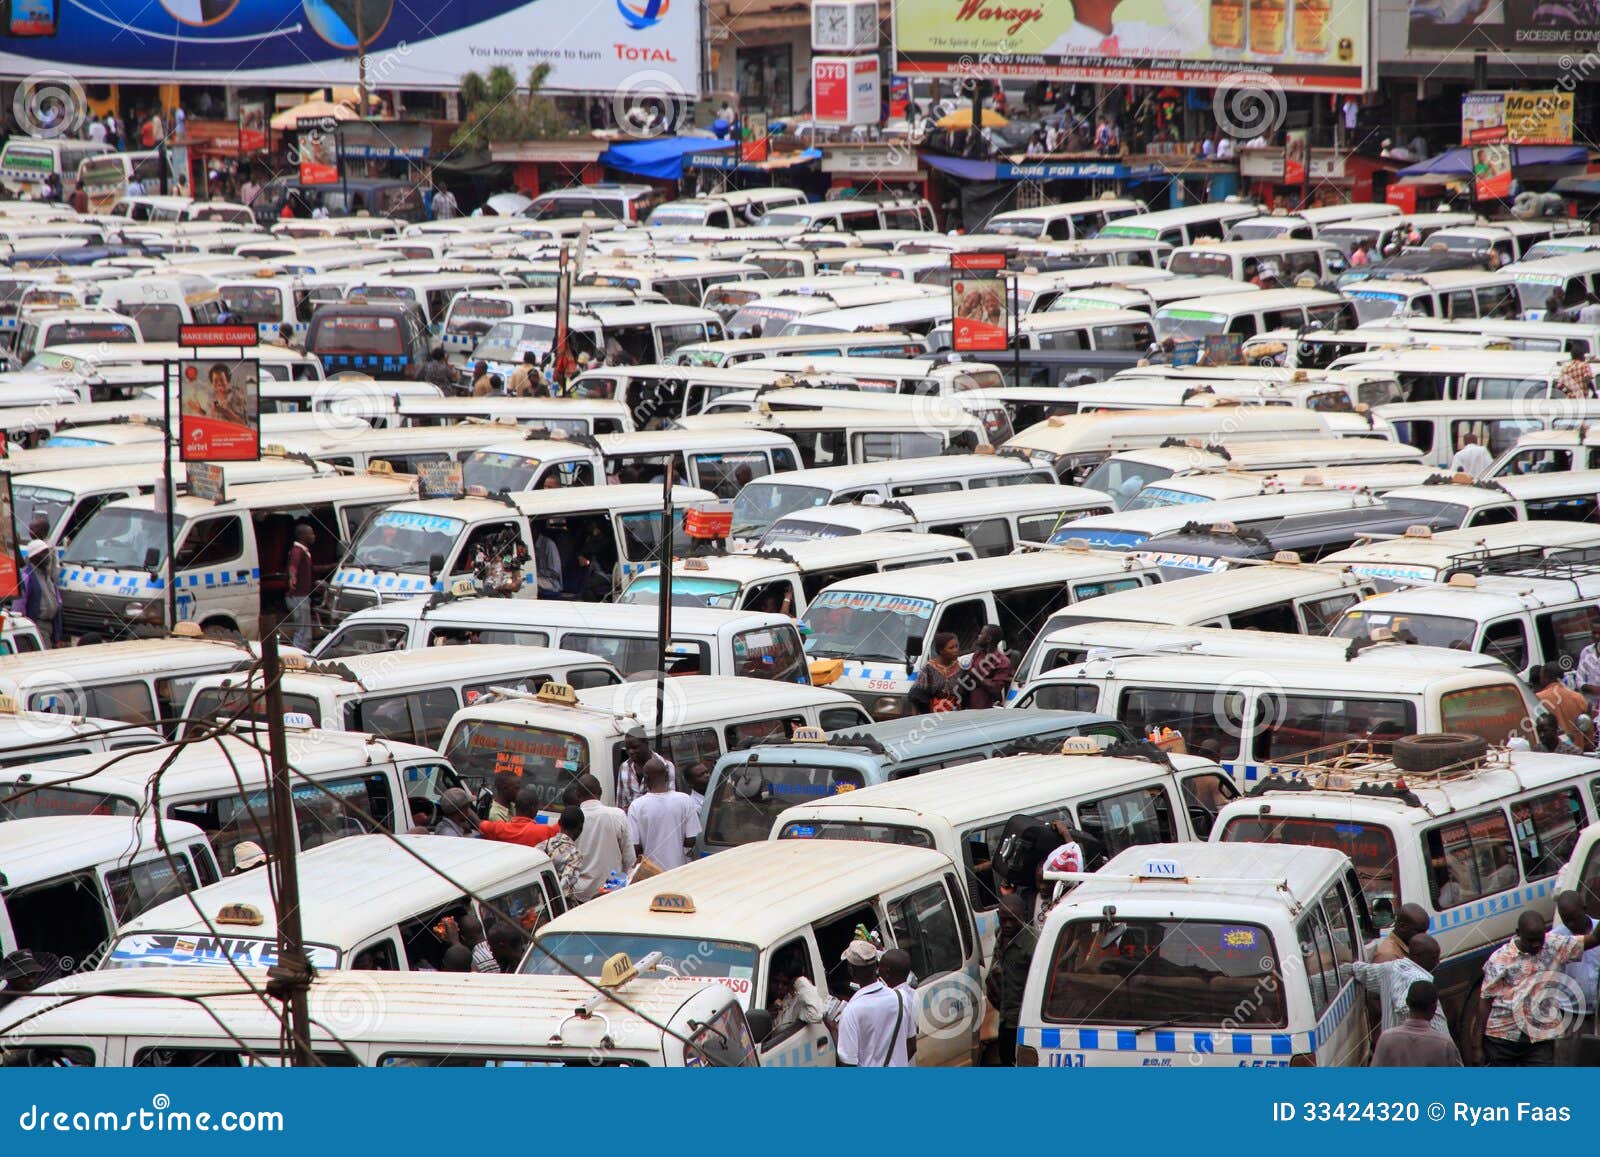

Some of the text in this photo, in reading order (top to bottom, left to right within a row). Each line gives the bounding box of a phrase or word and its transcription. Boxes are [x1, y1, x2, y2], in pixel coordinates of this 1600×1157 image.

[956, 0, 1044, 35] Waragi
[1516, 30, 1571, 40] EXCESSIVE
[468, 46, 601, 60] You know where to turn
[614, 44, 678, 62] TOTAL
[816, 65, 845, 79] DTB
[1507, 96, 1570, 110] Mobile
[1011, 166, 1045, 176] DARE
[1049, 166, 1074, 176] FOR
[187, 442, 208, 452] airtel
[389, 512, 452, 530] TOYOTA
[544, 684, 566, 696] TAXI
[868, 680, 896, 690] 598C
[796, 731, 818, 739] TAXI
[1146, 864, 1176, 874] TAXI
[657, 897, 687, 908] TAXI
[194, 937, 280, 966] NIKE
[612, 956, 630, 977] TAXI
